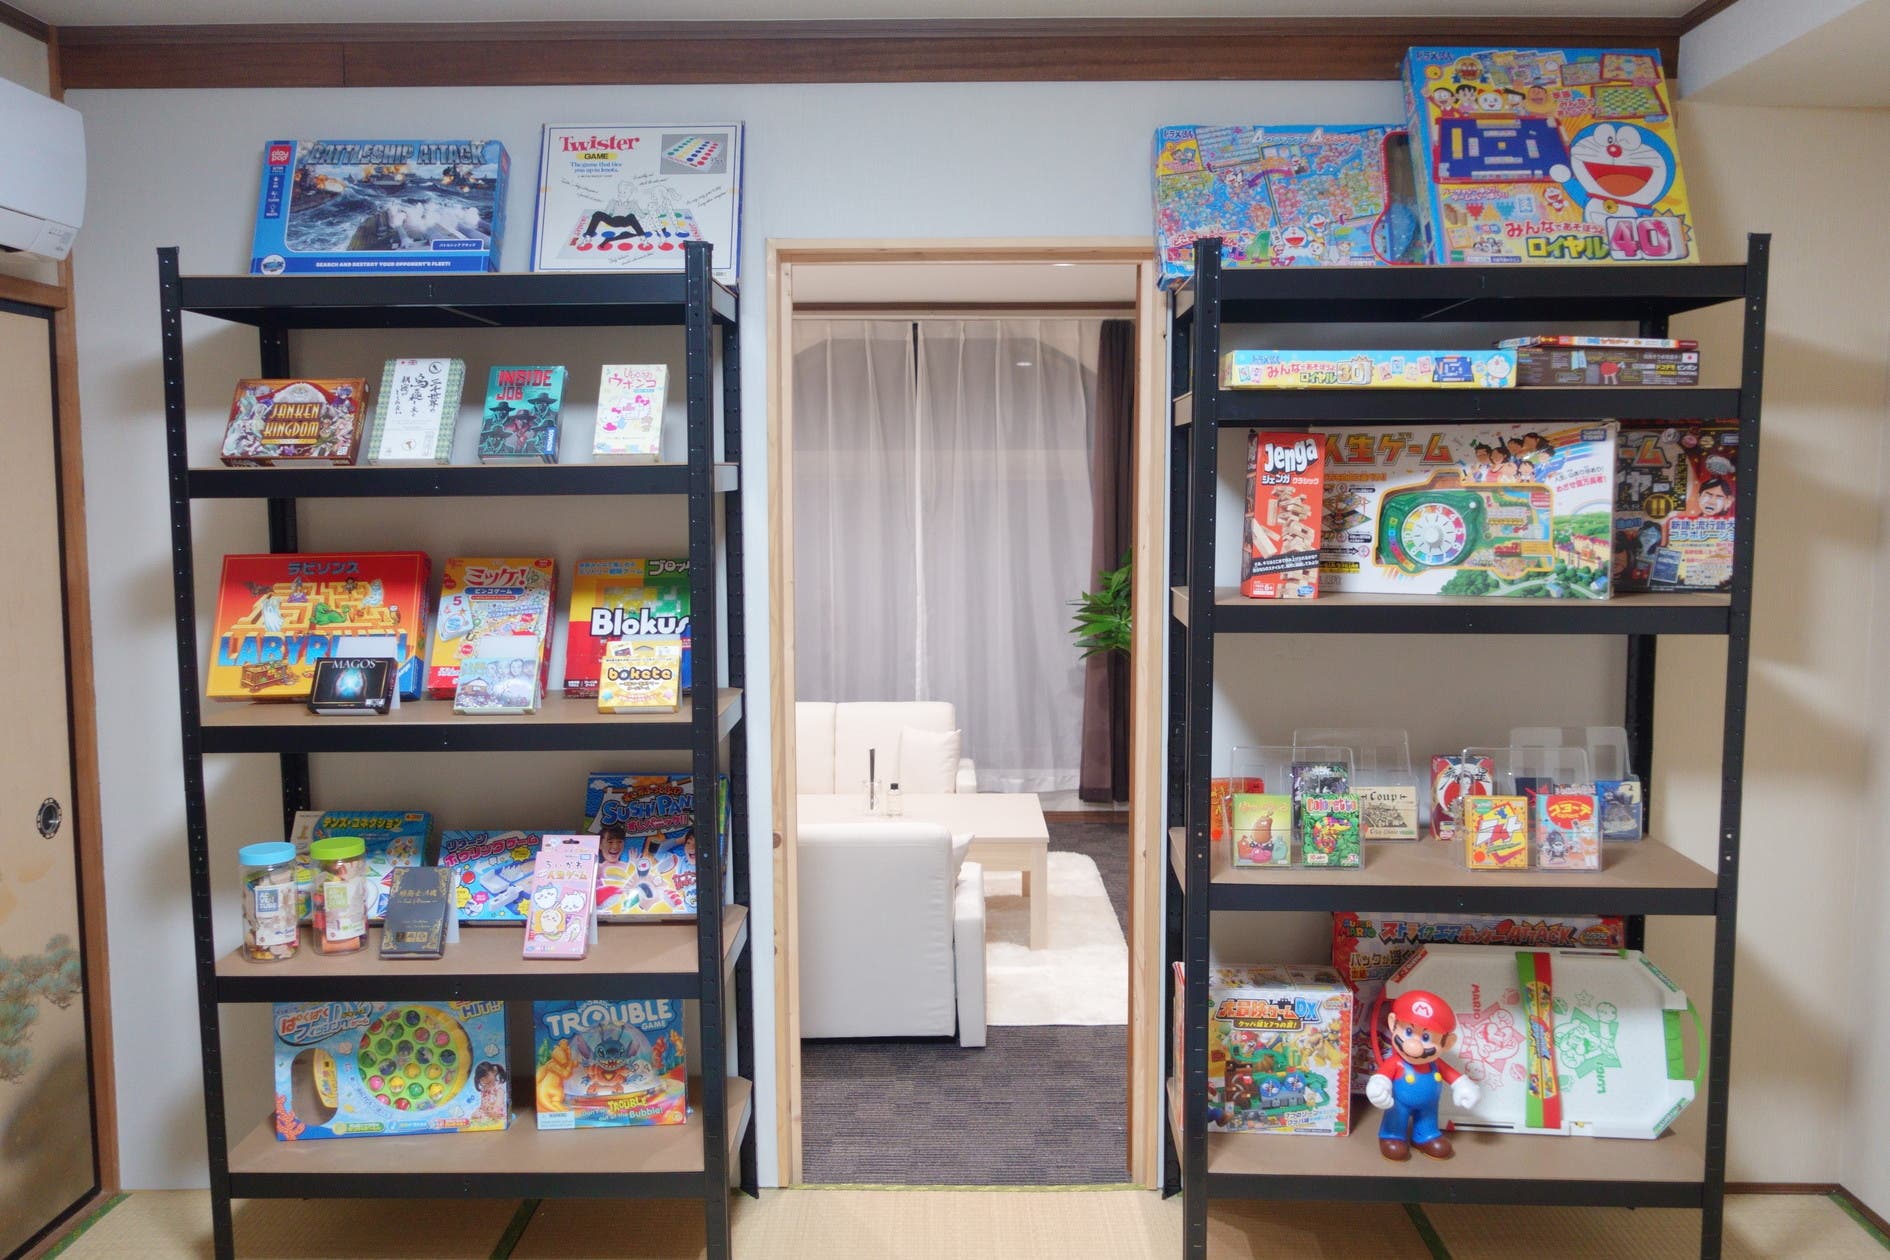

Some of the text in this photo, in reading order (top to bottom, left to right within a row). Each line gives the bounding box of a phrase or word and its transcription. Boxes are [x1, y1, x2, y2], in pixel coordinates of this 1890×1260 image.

[559, 135, 640, 152] Twister
[308, 143, 487, 165] BATTLESHIP ATTACK
[1527, 235, 1609, 259] ロイヤル
[1611, 220, 1671, 257] 40
[497, 369, 554, 387] INSIDE
[1338, 364, 1368, 382] 30
[496, 386, 524, 401] JOB
[271, 403, 320, 418] JANKEN
[262, 422, 319, 437] KINGDOM
[1264, 438, 1319, 473] Jenga
[1325, 432, 1454, 466] 人生ゲーム
[1262, 473, 1290, 485] ジェンガ
[288, 561, 360, 575] ラビリンス
[466, 567, 528, 585] ミッケ!
[453, 596, 462, 606] 5
[591, 607, 690, 636] Blokus
[332, 659, 376, 669] MAGOS
[608, 666, 672, 681] bokete
[1370, 791, 1398, 803] Coup
[601, 799, 655, 826] SUSHI
[1342, 926, 1376, 938] MARIO
[1344, 919, 1371, 928] SUPER
[1219, 998, 1317, 1020] 大冒険ゲーム DX
[1415, 1003, 1431, 1015] M
[1472, 983, 1481, 1019] MARIO
[547, 1000, 672, 1036] TROUBLE
[642, 1021, 666, 1029] GAME
[1596, 1062, 1606, 1095] LUIGI
[607, 1096, 648, 1113] TROUBLE
[629, 1107, 664, 1118] Bubble!
